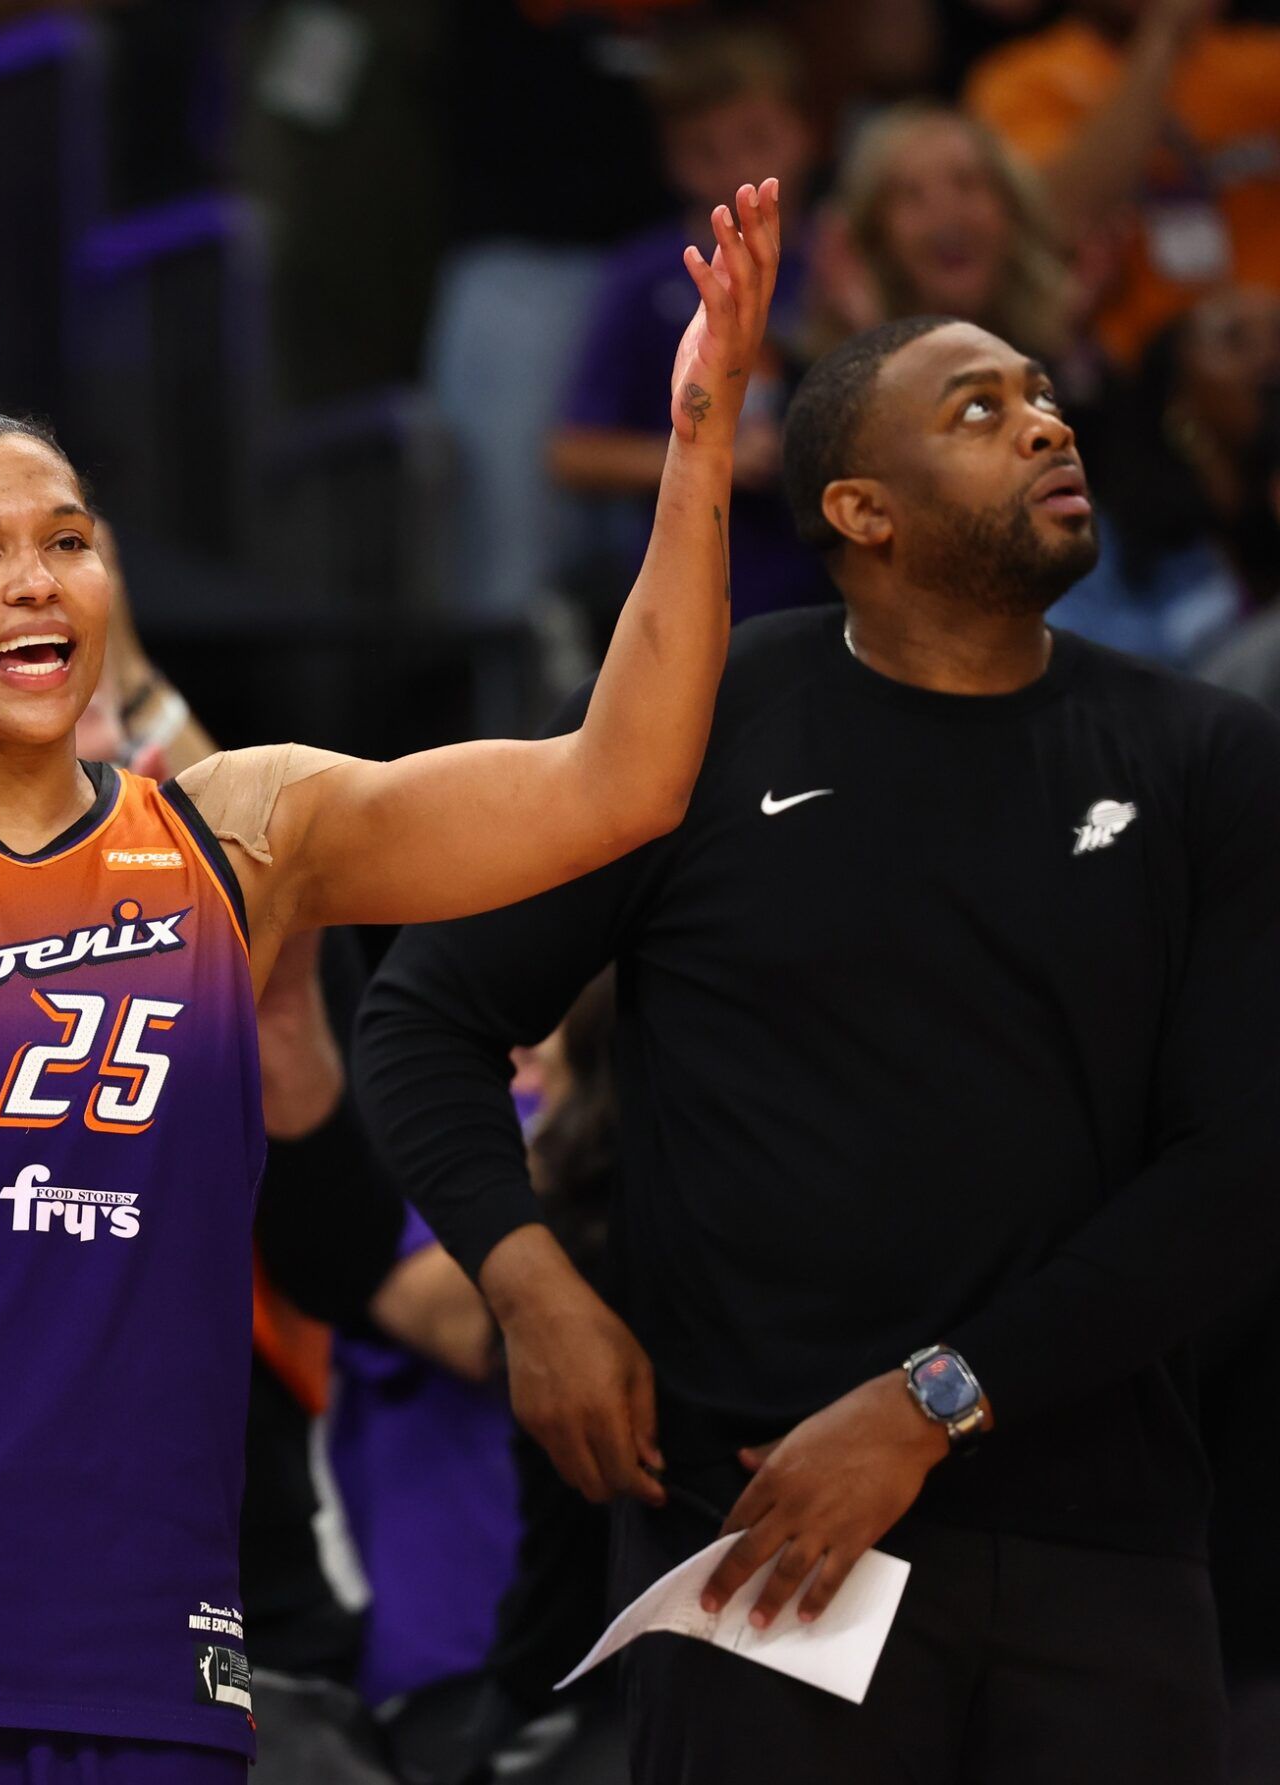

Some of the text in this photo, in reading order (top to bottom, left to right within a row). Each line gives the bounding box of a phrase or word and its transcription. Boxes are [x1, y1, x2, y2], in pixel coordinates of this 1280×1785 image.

[36, 1188, 132, 1204] FOOD STORES
[189, 1615, 211, 1630] NIKE
